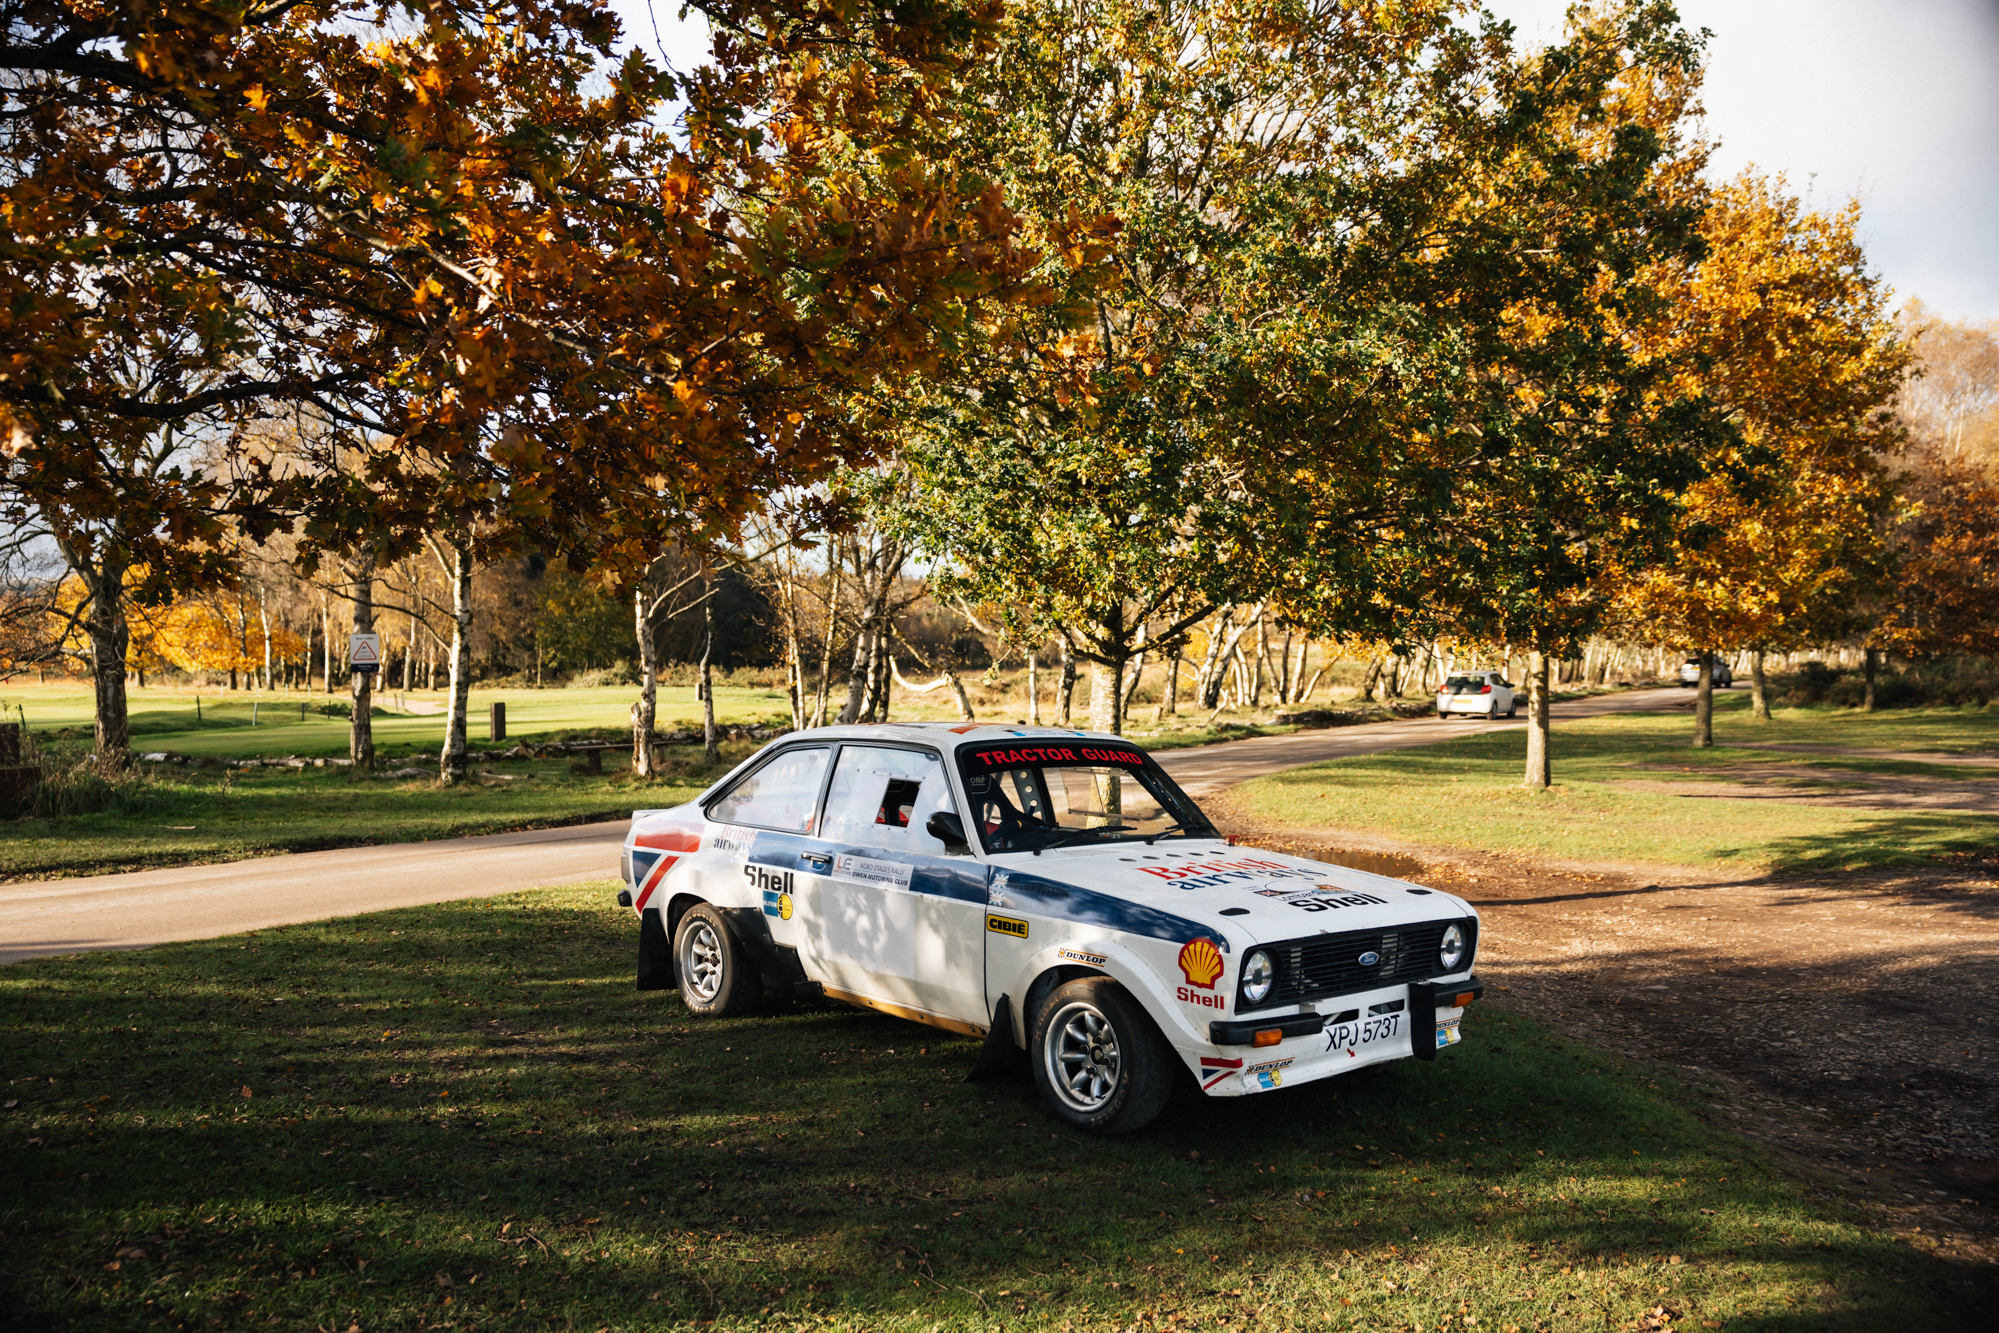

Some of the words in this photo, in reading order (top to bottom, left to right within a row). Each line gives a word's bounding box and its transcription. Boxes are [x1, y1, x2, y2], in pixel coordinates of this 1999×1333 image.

[976, 748, 1078, 766] TRACTOR
[1082, 748, 1143, 765] GUARD
[720, 824, 757, 843] British
[713, 837, 753, 853] airways
[852, 871, 867, 879] OWEN
[868, 873, 893, 884] MOTORING
[894, 878, 909, 886] CLUB
[1136, 858, 1290, 880] British
[744, 864, 794, 895] Shell
[1008, 878, 1036, 892] WILLIAM
[1037, 883, 1070, 899] RUSHTON
[1167, 868, 1327, 891] airways
[1288, 893, 1389, 913] Shell
[1066, 951, 1106, 965] DUNLOP
[1177, 986, 1225, 1010] Shell
[1325, 1022, 1359, 1052] XPJ
[1362, 1014, 1400, 1043] 573T
[1254, 1059, 1294, 1072] DUNLOP
